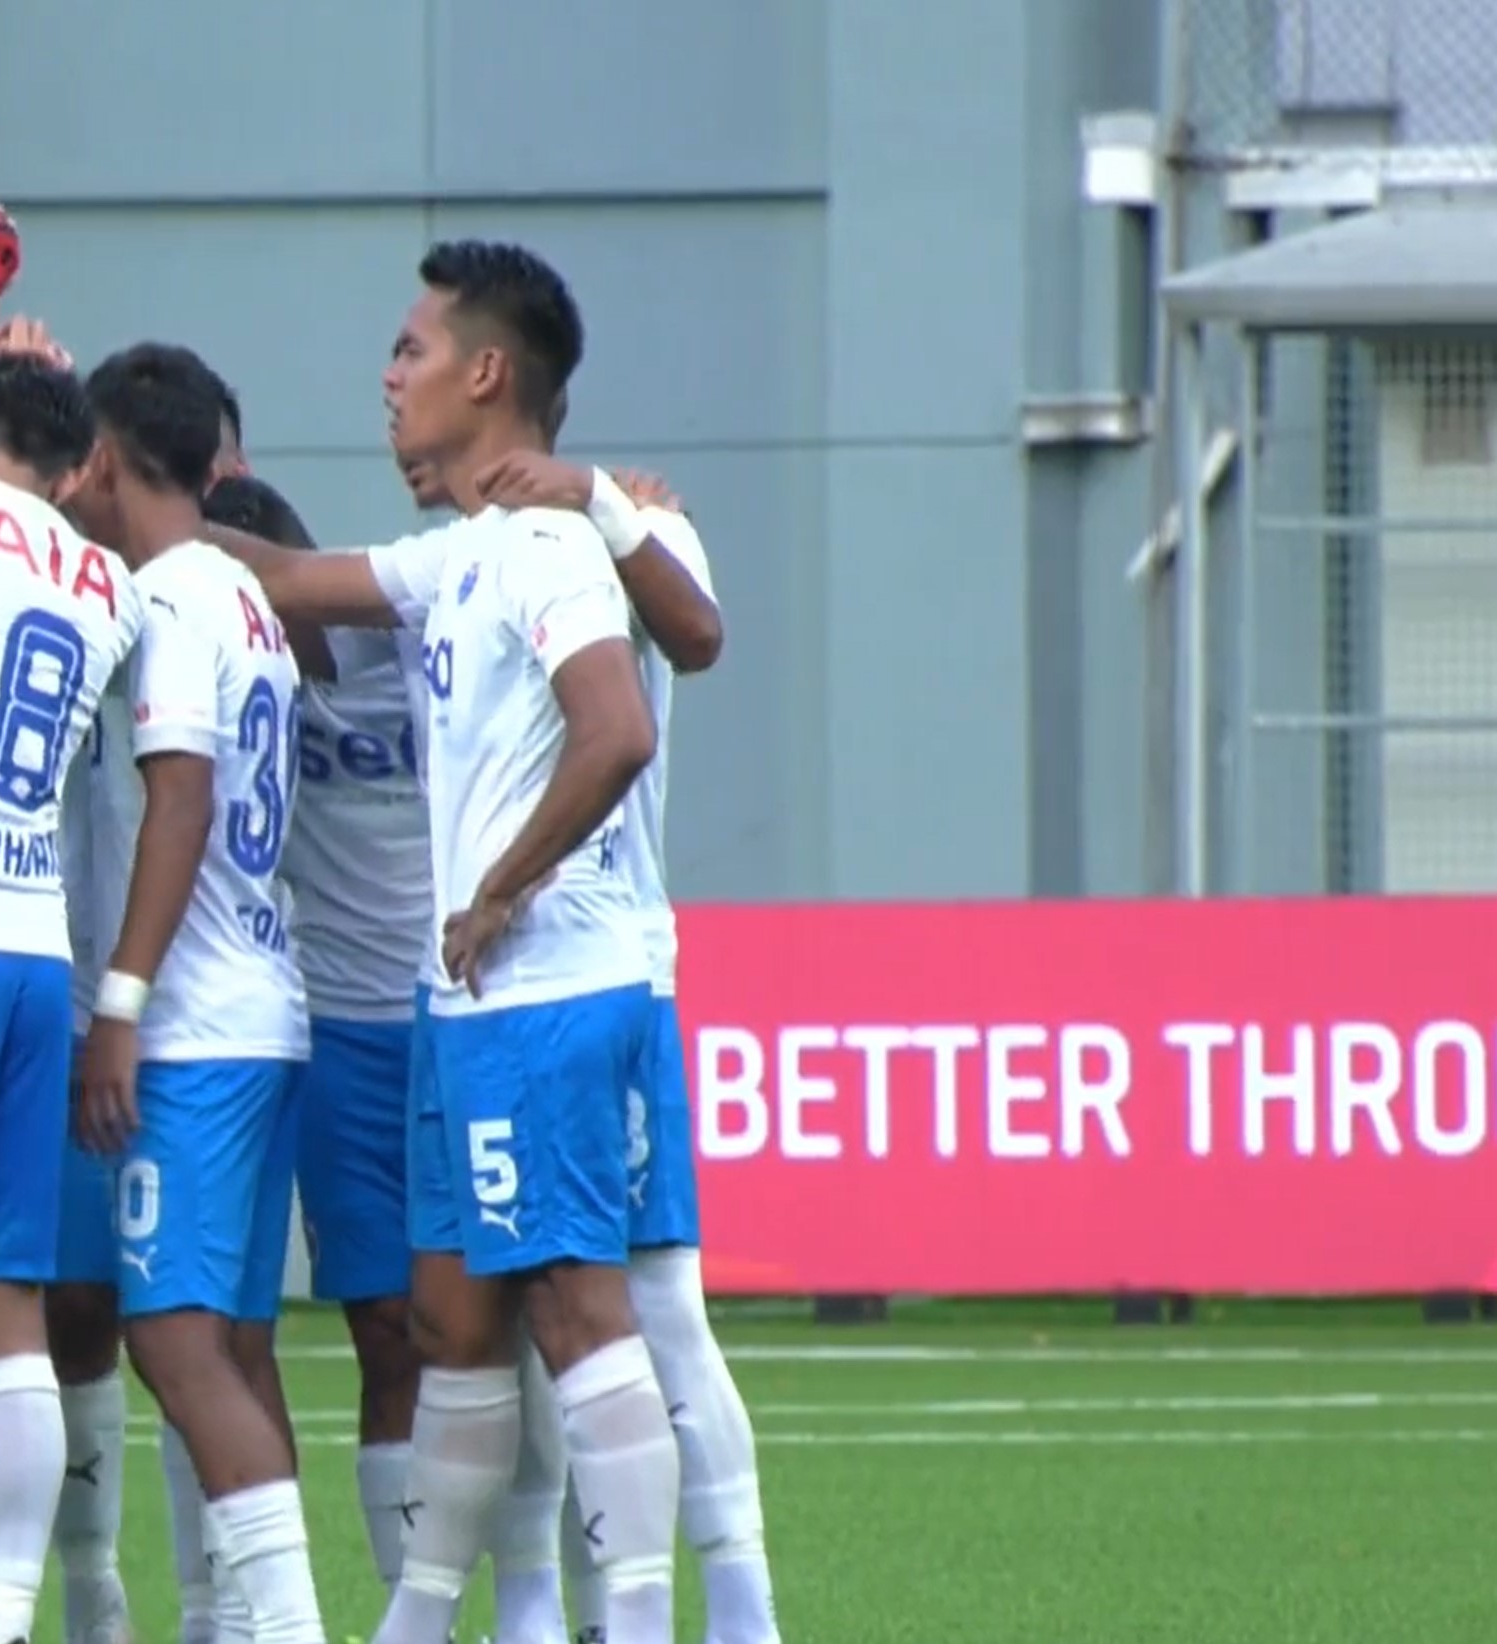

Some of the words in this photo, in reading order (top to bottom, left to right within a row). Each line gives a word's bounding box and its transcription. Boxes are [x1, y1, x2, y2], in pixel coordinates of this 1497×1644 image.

[698, 1025, 1130, 1158] BETTER
[1163, 1020, 1487, 1156] THRO
[469, 1119, 517, 1203] 5
